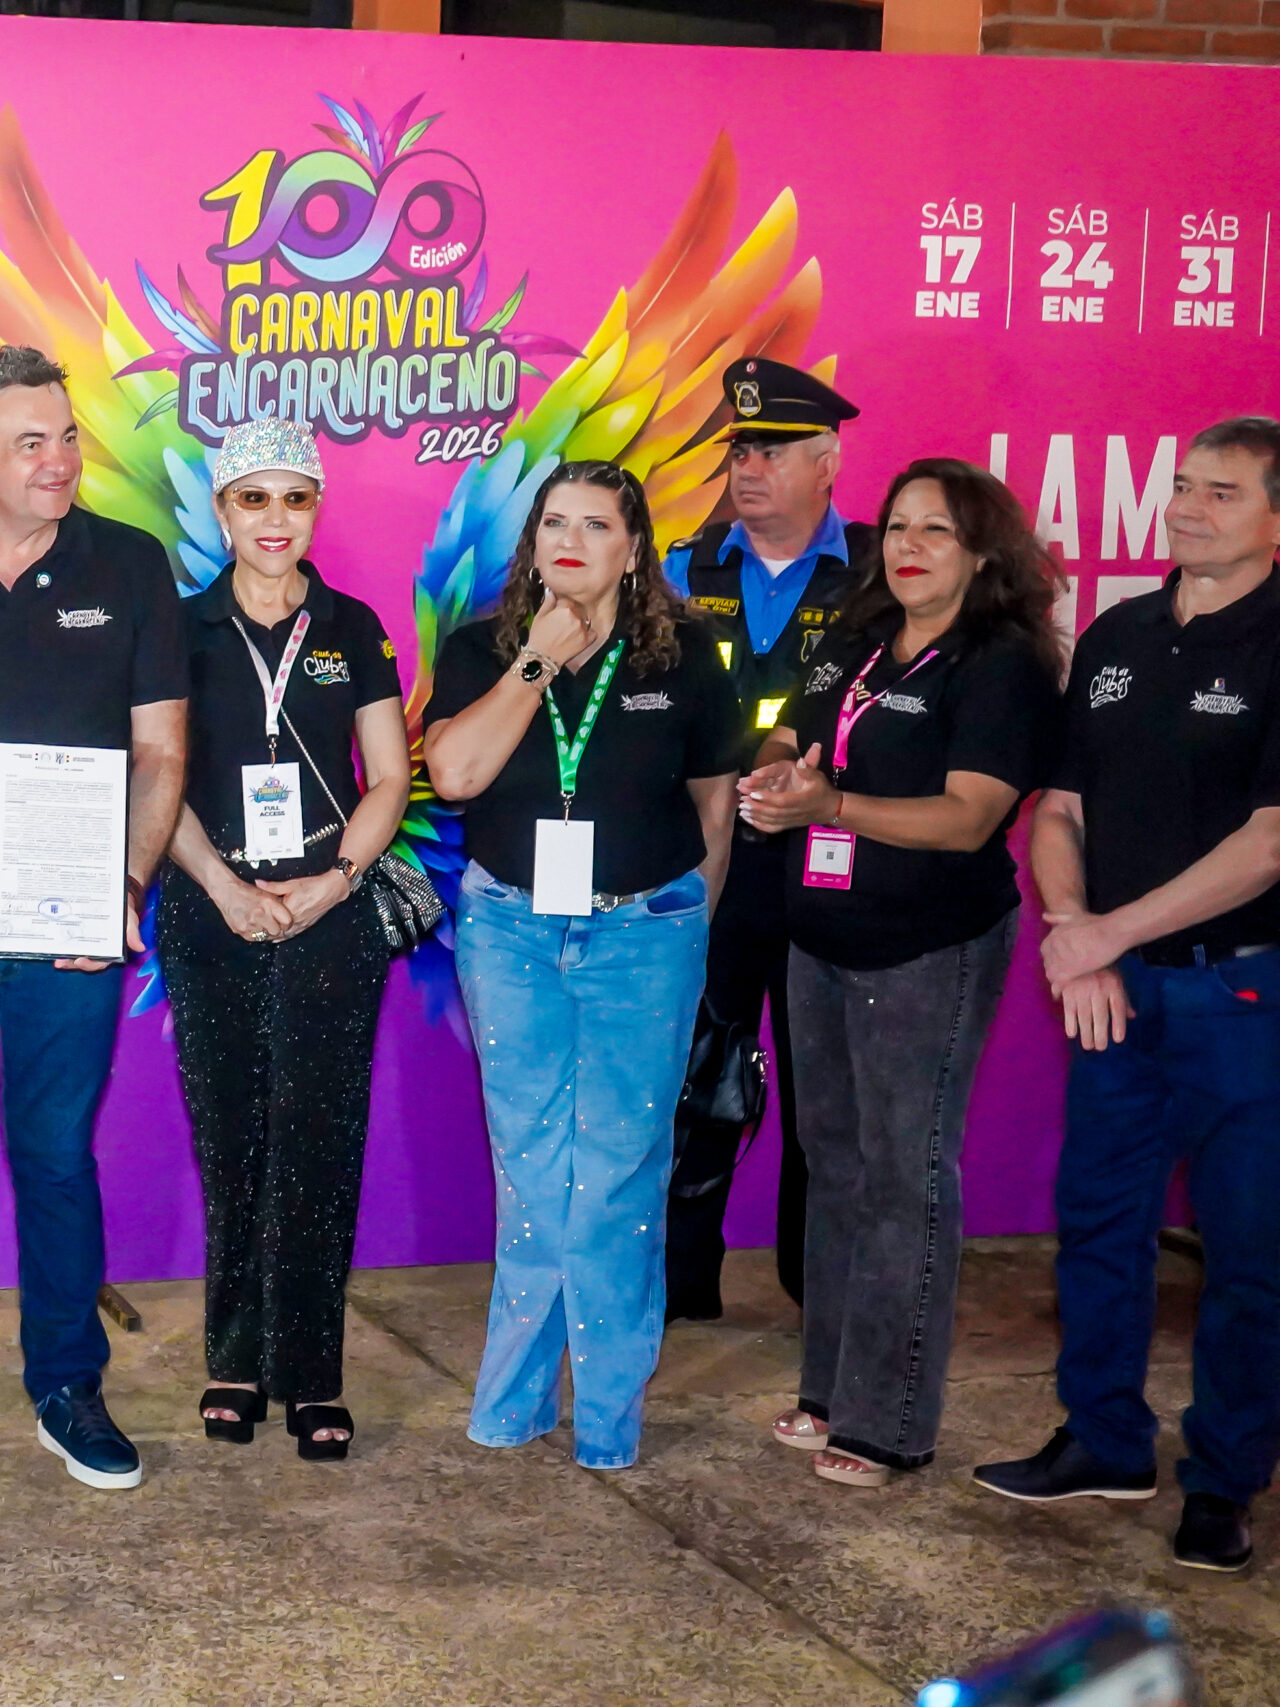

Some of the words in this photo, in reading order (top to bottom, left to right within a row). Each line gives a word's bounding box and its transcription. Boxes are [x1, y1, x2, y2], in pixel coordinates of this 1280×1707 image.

[921, 197, 983, 230] SÁB
[1048, 204, 1109, 236] SÁB
[1180, 209, 1239, 241] SÁB
[409, 241, 468, 269] Edición
[920, 235, 982, 284] 17
[1040, 240, 1114, 290] 24
[1177, 246, 1235, 294] 31
[229, 286, 470, 354] CARNAVAL
[915, 291, 981, 319] ENE
[1041, 296, 1105, 323] ENE
[1174, 301, 1235, 328] ENE
[418, 422, 506, 463] 2026
